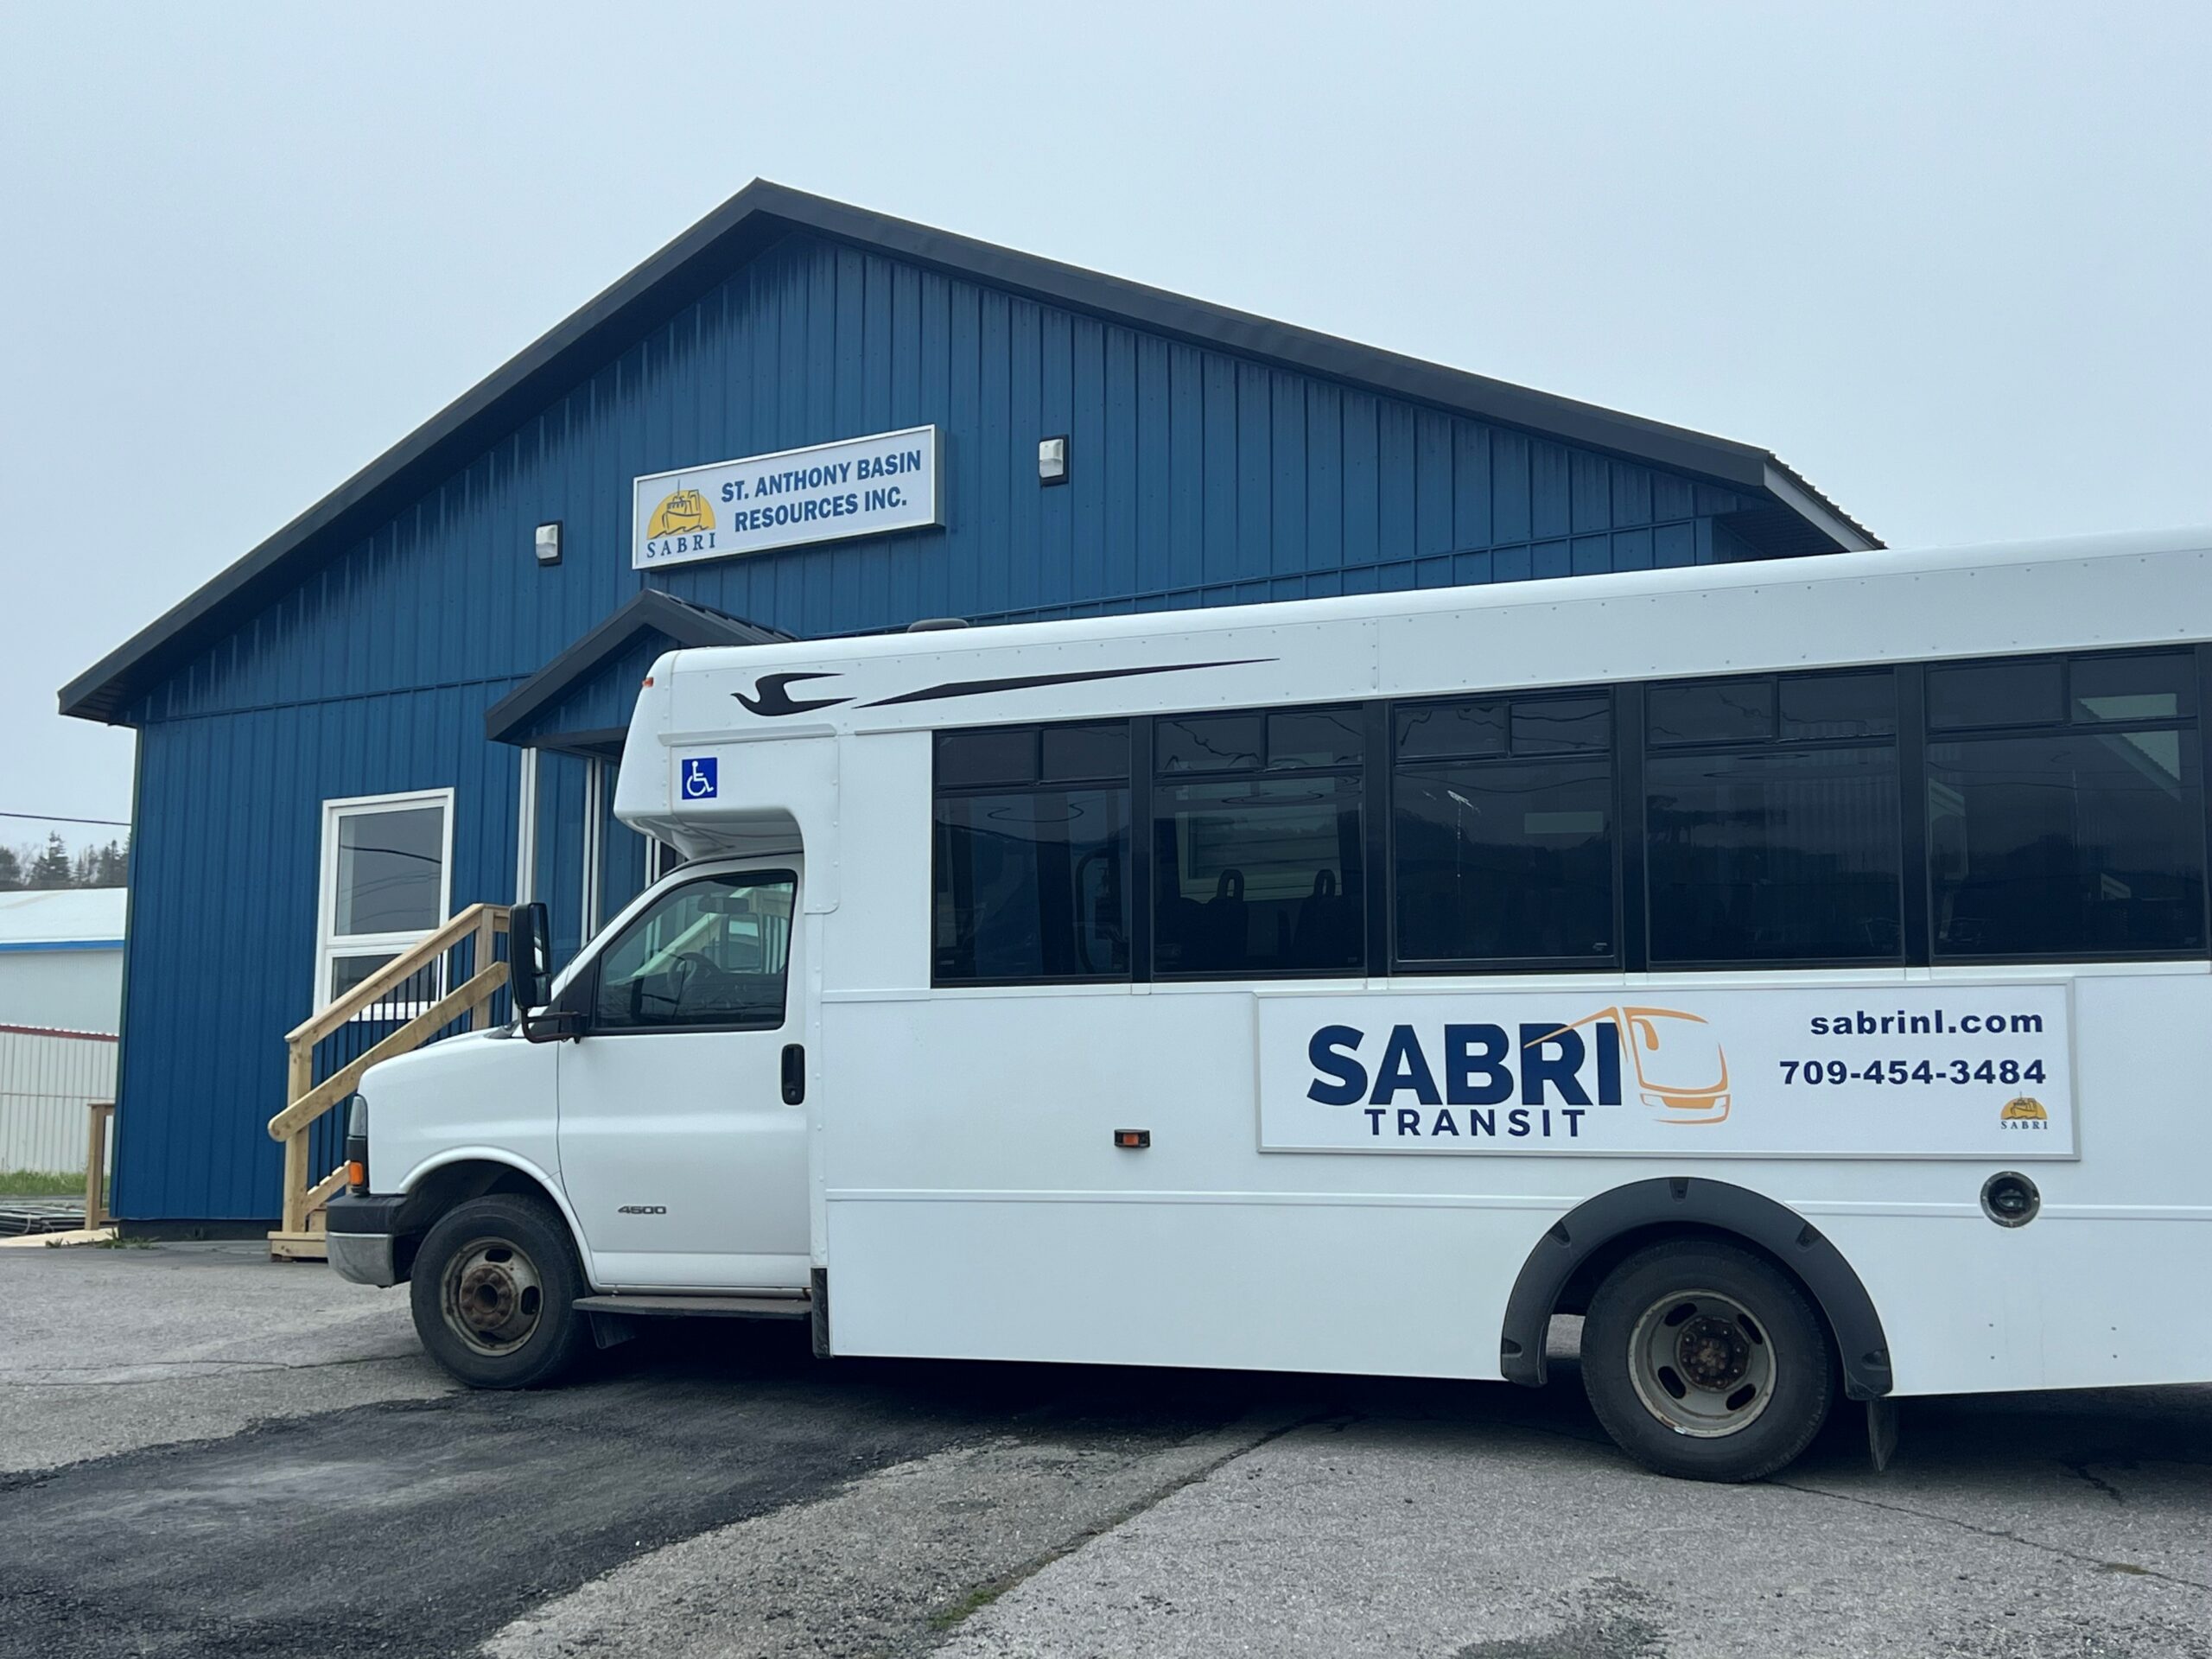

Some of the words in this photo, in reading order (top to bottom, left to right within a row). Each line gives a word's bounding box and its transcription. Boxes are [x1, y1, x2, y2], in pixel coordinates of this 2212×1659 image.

[721, 480, 749, 503] ST.
[755, 461, 851, 498] ANTHONY
[856, 450, 921, 480] BASIN
[734, 493, 858, 532] RESOURCES
[865, 486, 906, 512] INC.
[646, 532, 715, 558] SABRI
[1810, 1009, 2044, 1035] sabrinl.com
[1306, 1022, 1623, 1107] SABRI
[1779, 1059, 2046, 1085] 709-454-3484
[1364, 1109, 1586, 1137] TRANSIT
[2000, 1120, 2048, 1130] SABRI
[617, 1205, 667, 1215] 4500
